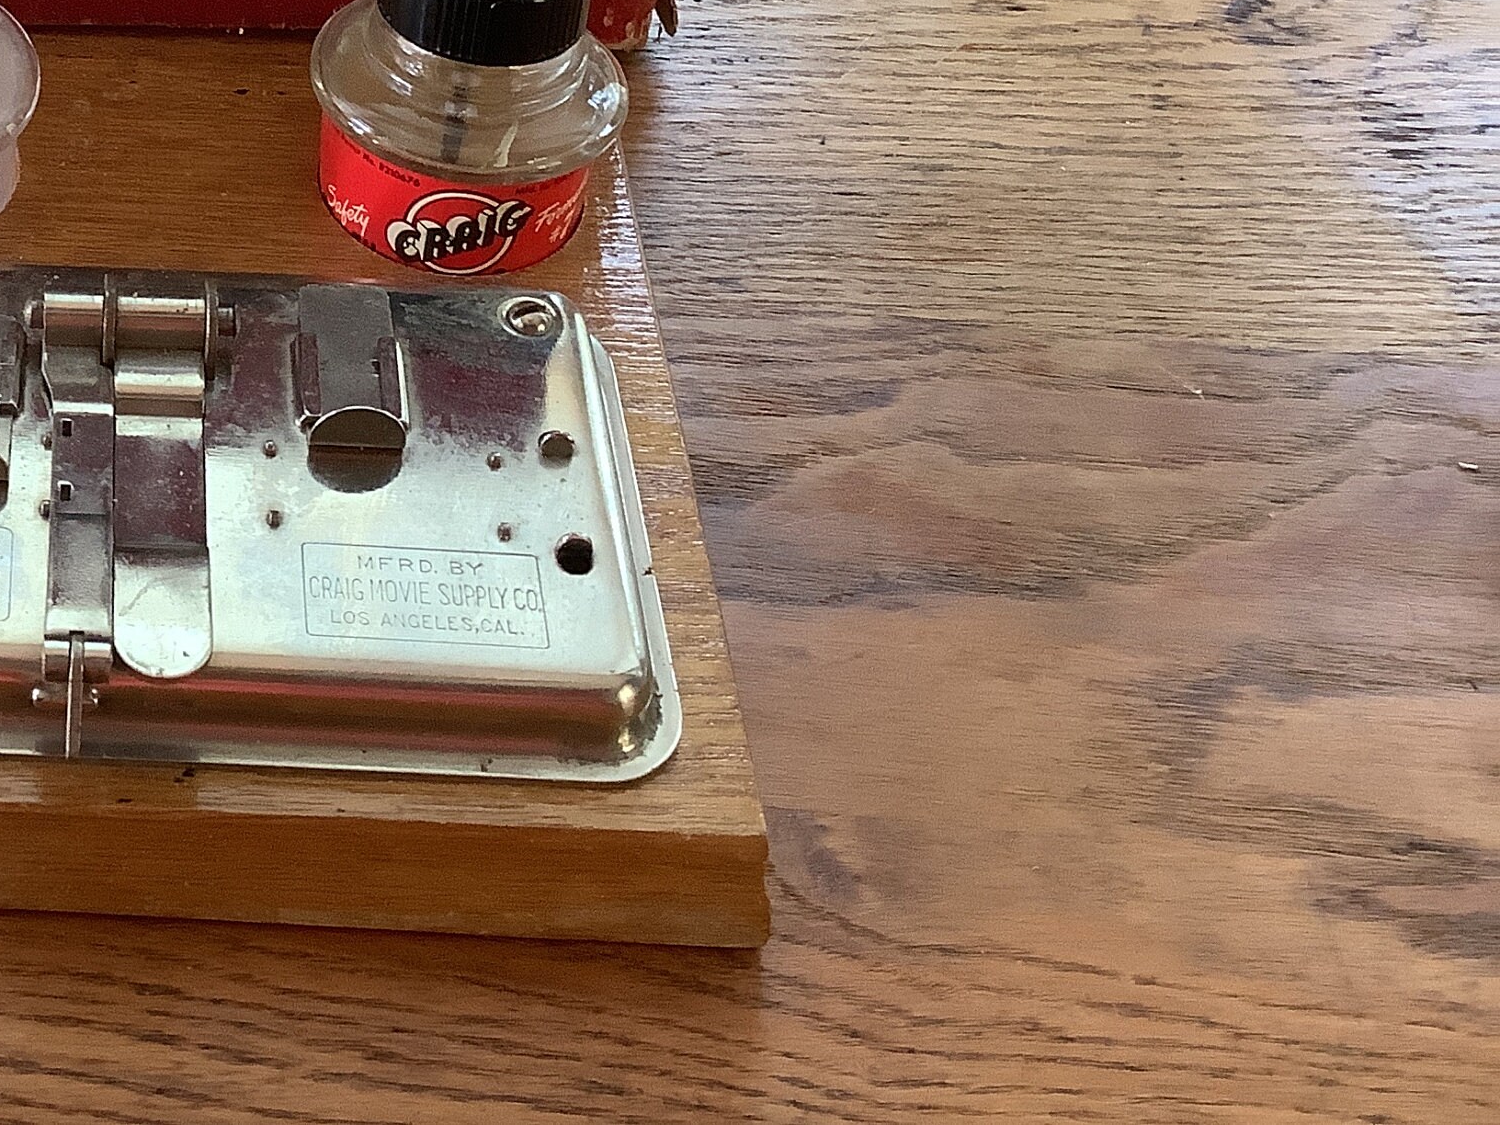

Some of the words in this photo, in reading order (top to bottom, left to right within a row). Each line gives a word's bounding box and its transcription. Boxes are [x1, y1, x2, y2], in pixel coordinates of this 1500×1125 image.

[327, 184, 370, 237] Safety
[386, 200, 534, 262] CRAIG
[357, 555, 438, 575] MFRD.
[450, 561, 483, 576] BY
[309, 575, 364, 601] CRAIG
[370, 579, 431, 605] MOVIE
[438, 583, 508, 610] SUPPLY
[513, 587, 543, 613] CO.
[330, 609, 370, 625] LOS
